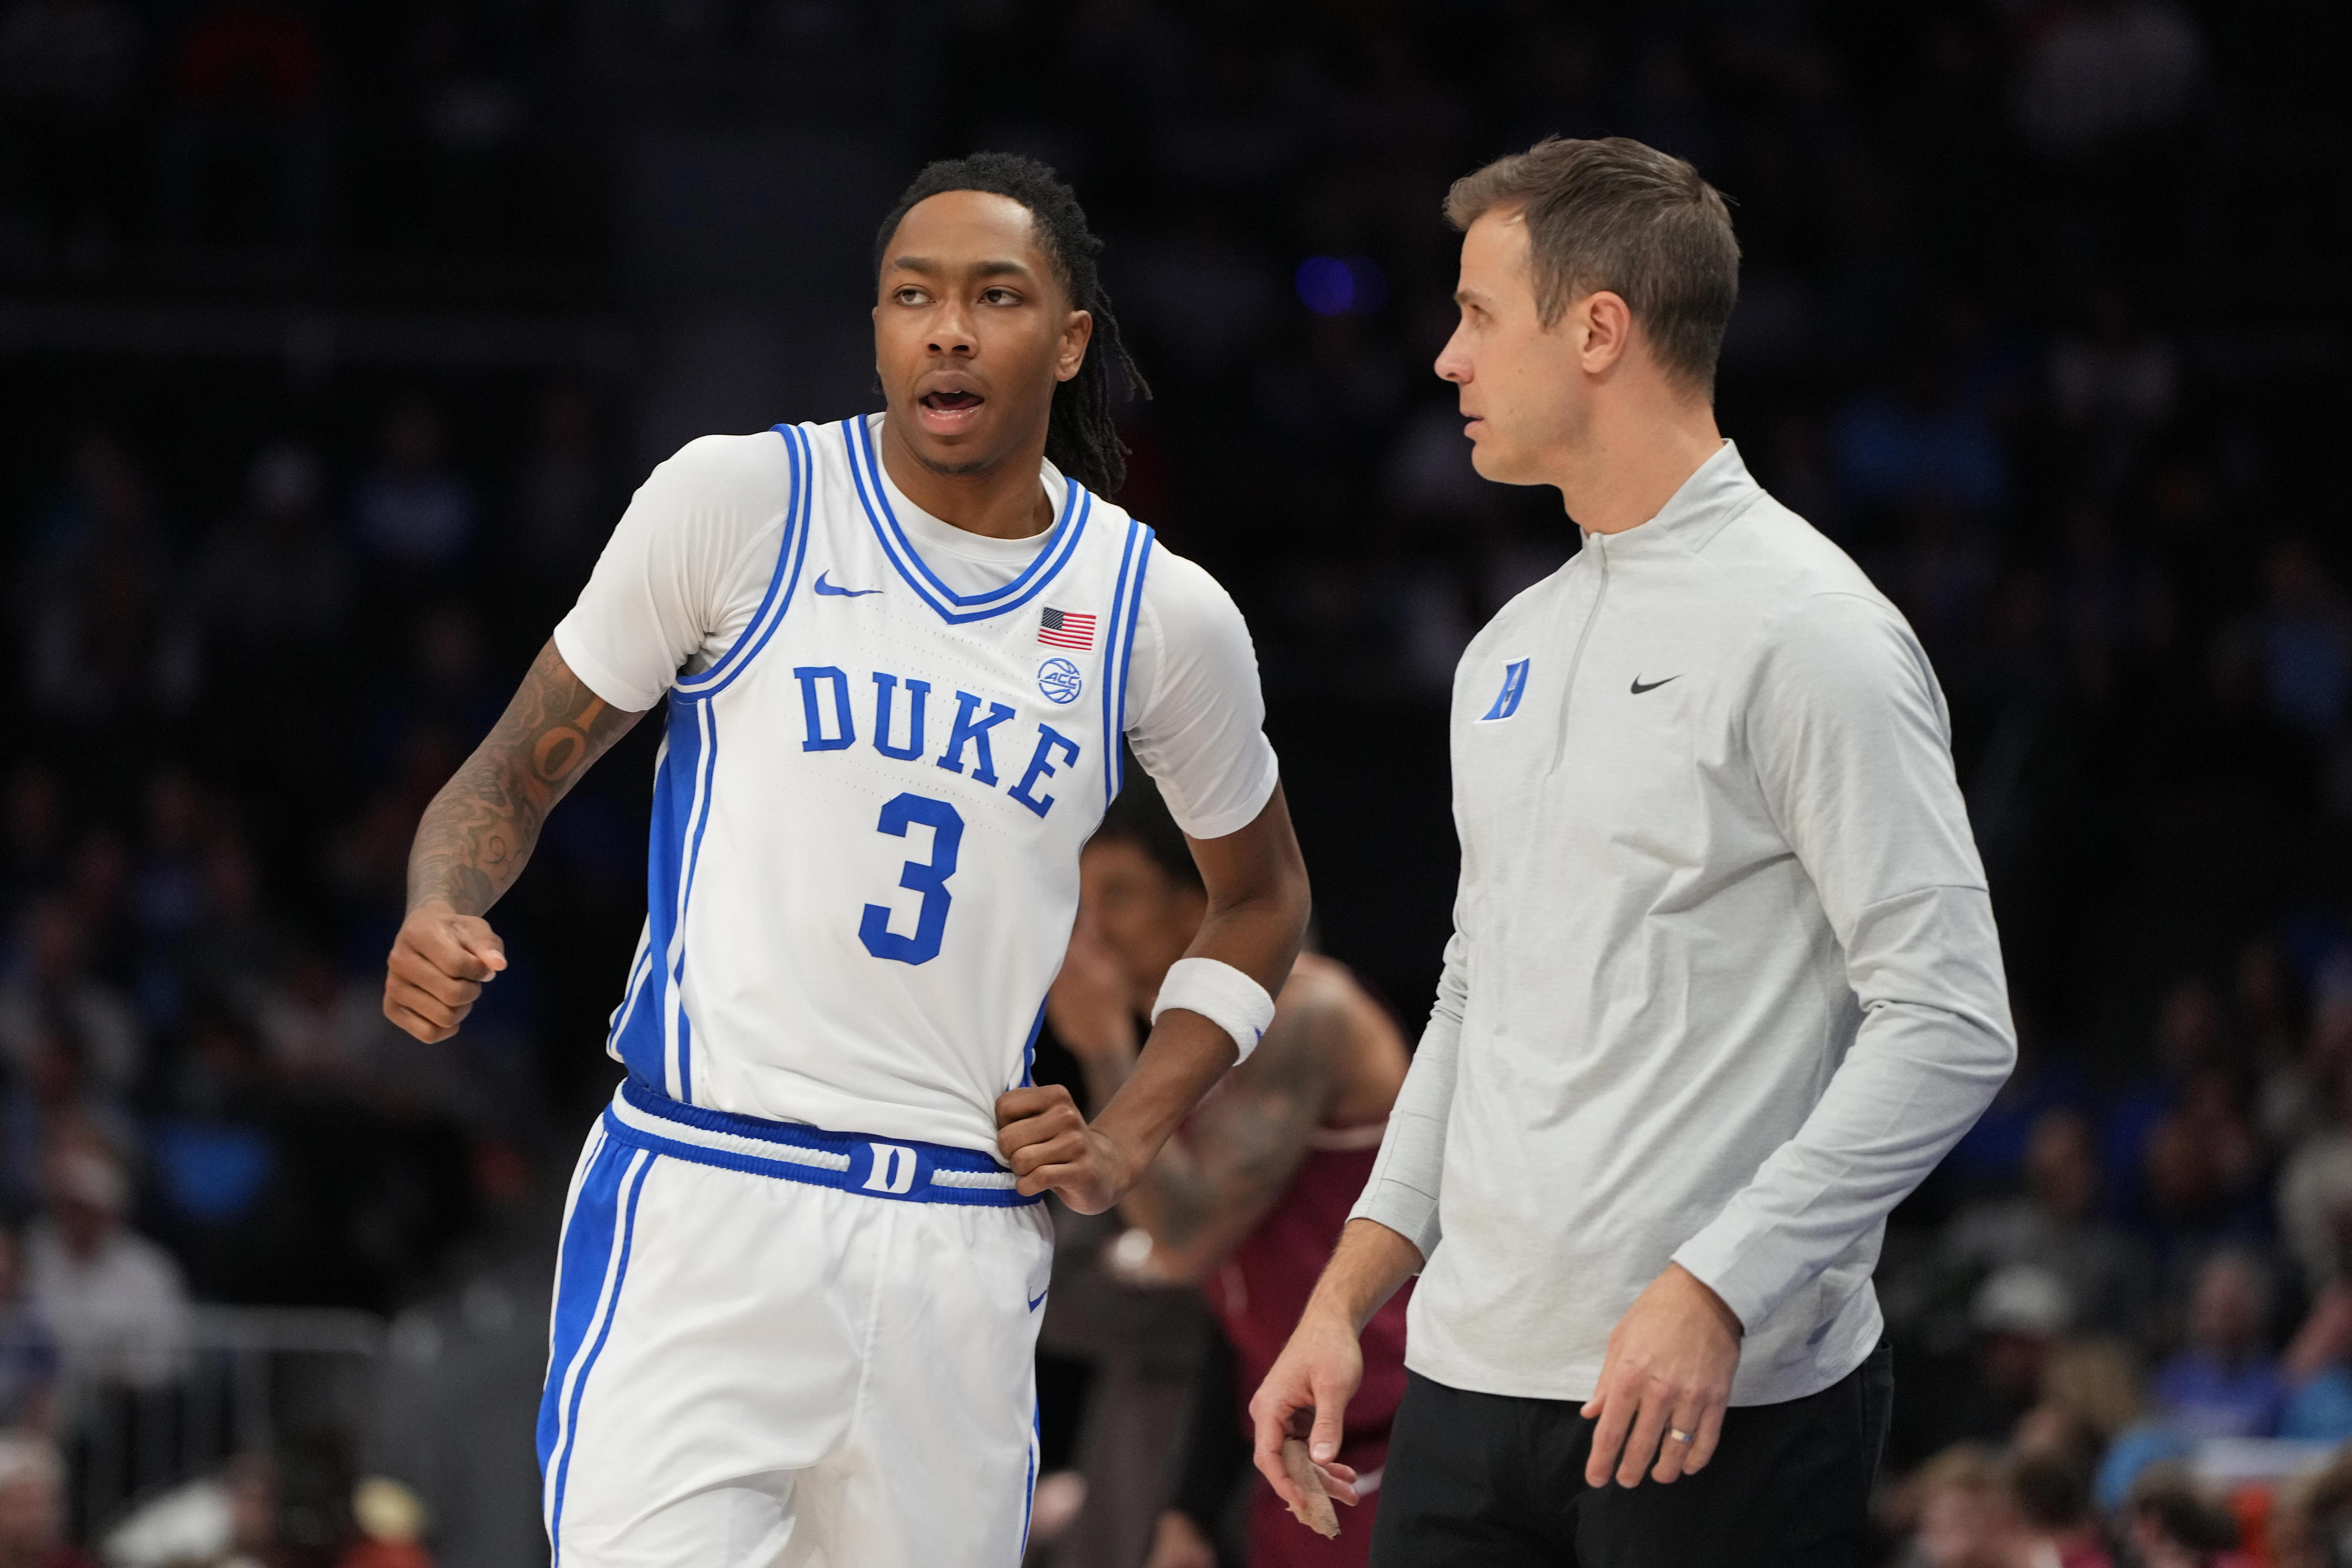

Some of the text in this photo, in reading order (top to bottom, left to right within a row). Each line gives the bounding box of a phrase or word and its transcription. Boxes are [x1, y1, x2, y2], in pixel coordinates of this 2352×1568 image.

[1044, 672, 1081, 686] ACC
[793, 666, 1080, 818] DUKE
[858, 792, 964, 965] 3
[862, 1142, 917, 1194] D
